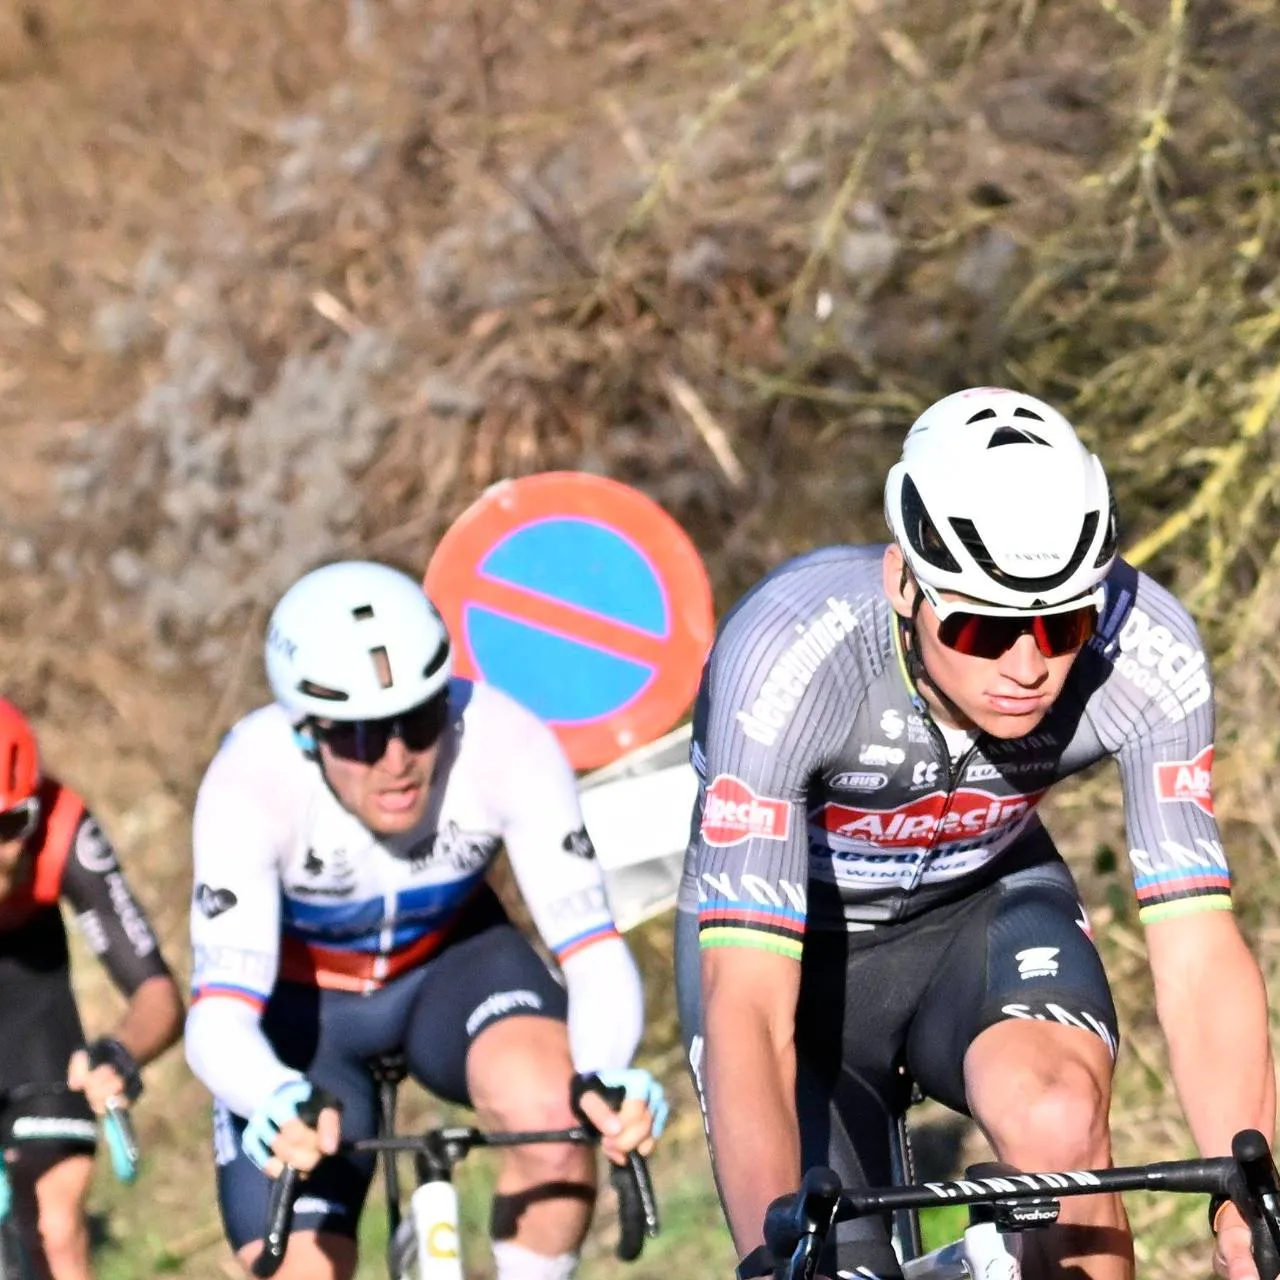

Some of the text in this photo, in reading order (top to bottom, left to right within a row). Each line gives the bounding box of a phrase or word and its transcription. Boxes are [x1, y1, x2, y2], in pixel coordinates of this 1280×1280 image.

[737, 596, 858, 746] deceuninck
[838, 800, 1029, 840] Alpecin
[925, 1171, 1101, 1198] CANYON
[1013, 1209, 1058, 1222] wahoo
